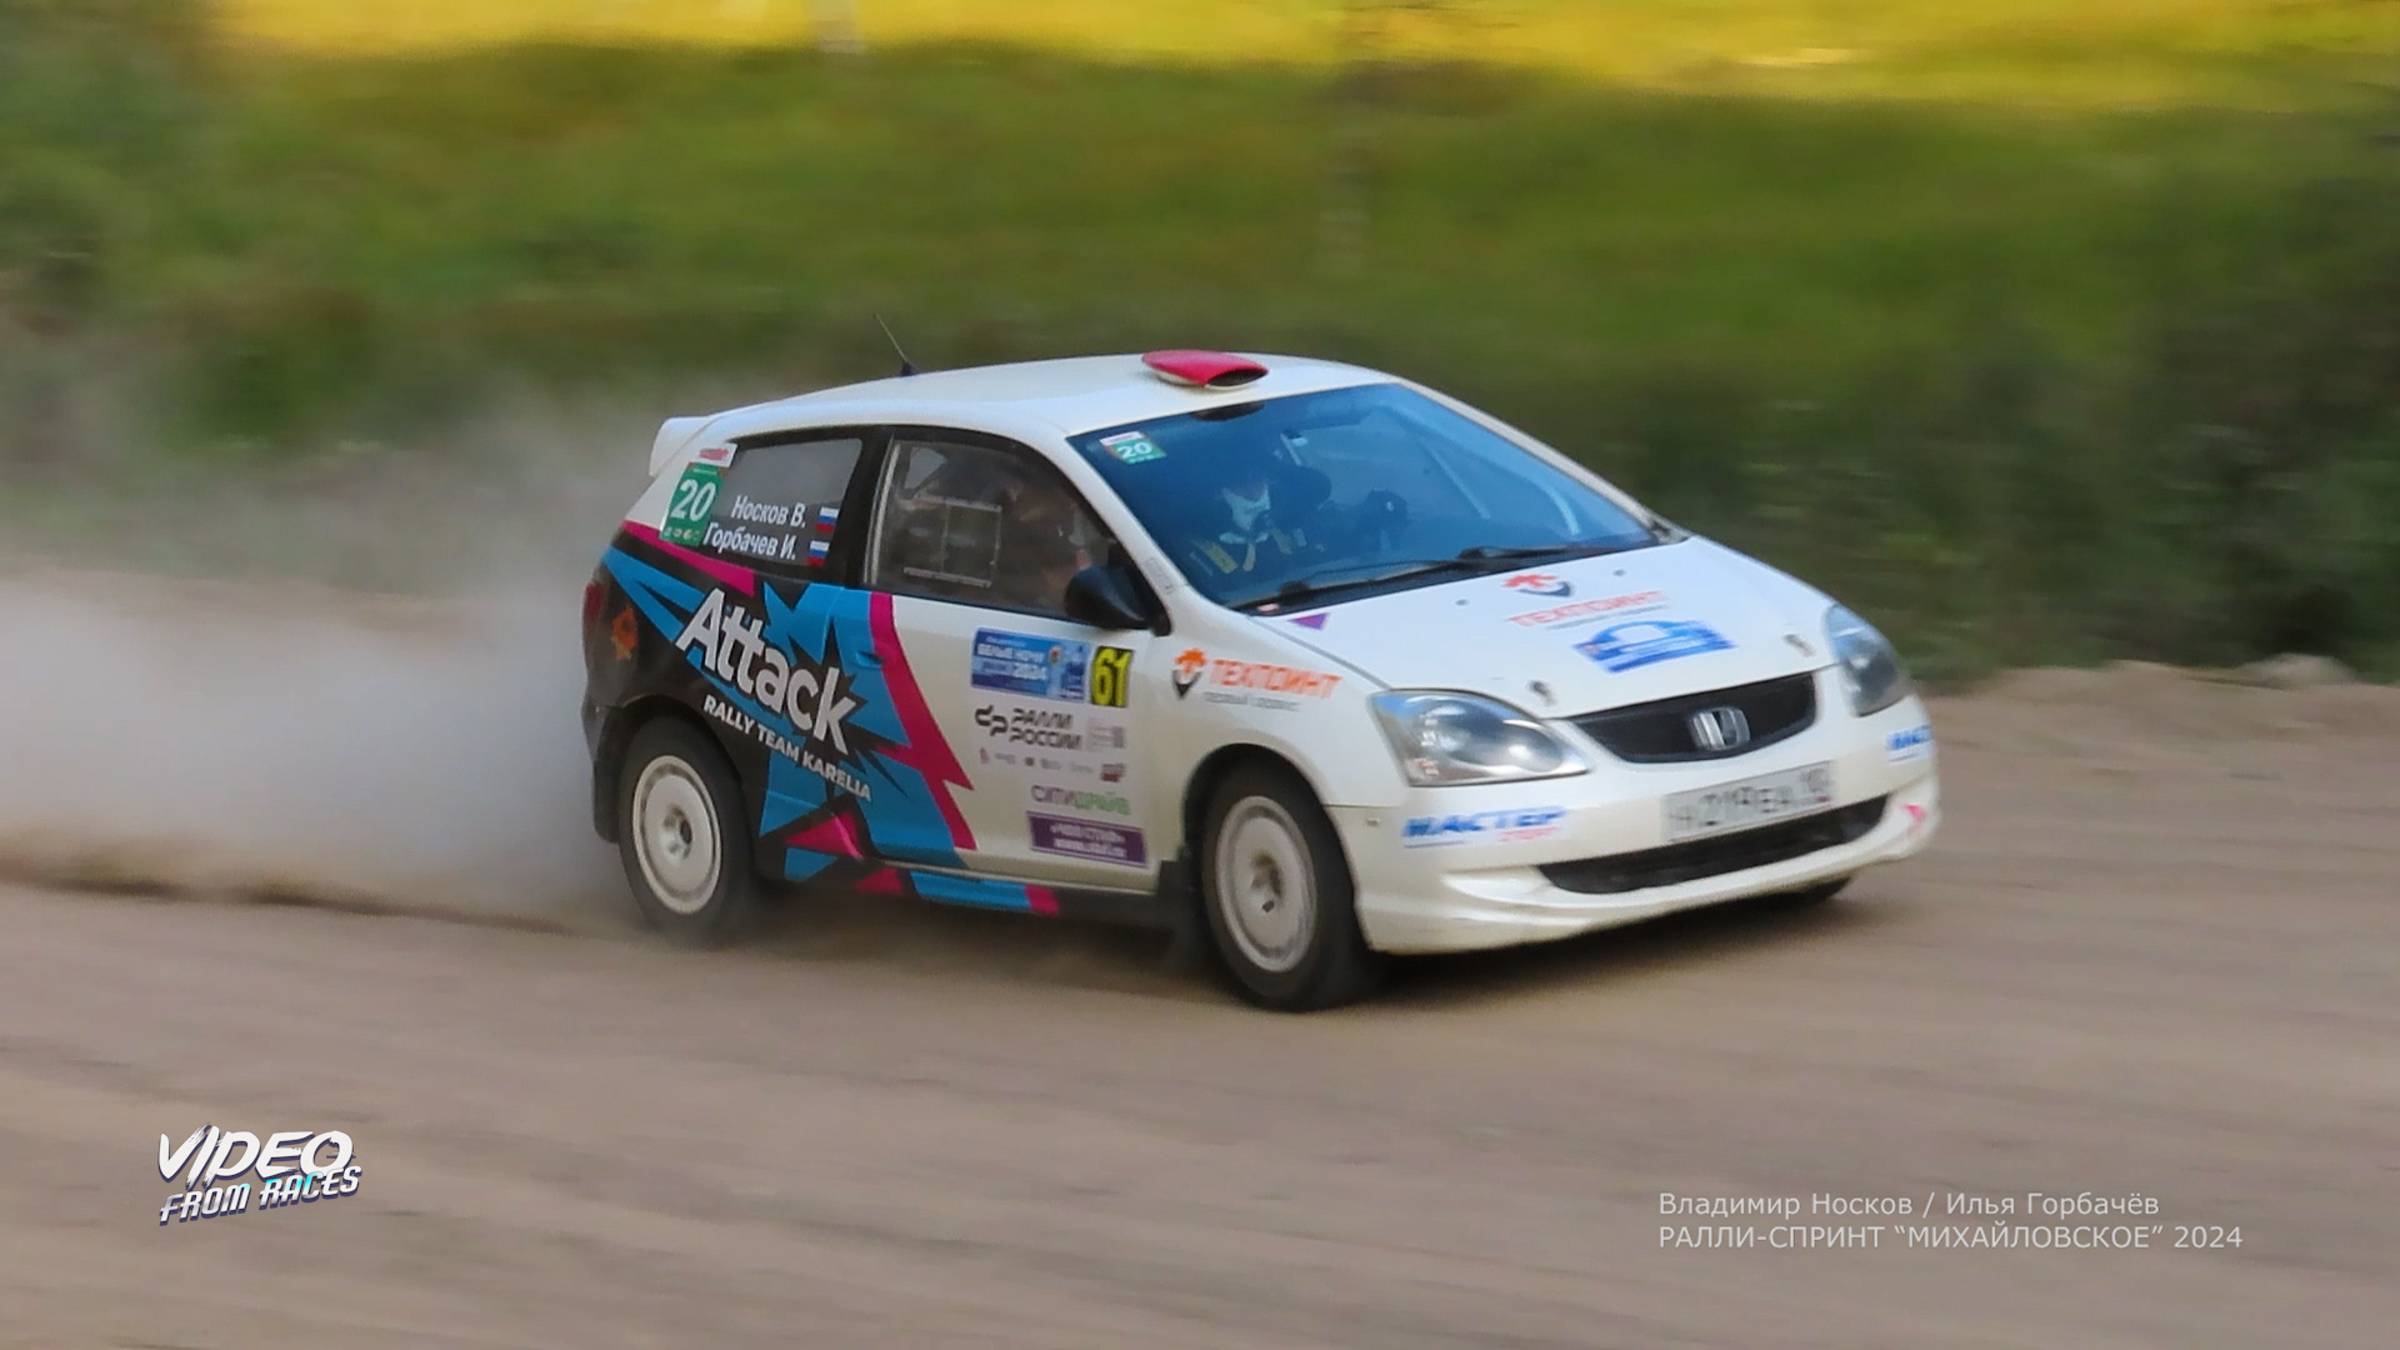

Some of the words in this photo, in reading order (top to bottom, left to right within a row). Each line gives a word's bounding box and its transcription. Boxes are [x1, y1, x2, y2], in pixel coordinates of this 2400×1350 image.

[1117, 441, 1153, 459] 20
[670, 479, 717, 522] 20
[731, 495, 788, 525] Носков
[789, 501, 807, 528] В.
[702, 521, 779, 560] Горбачев
[780, 536, 797, 560] И.
[675, 587, 856, 754] Attack
[1091, 646, 1133, 708] 61
[1011, 707, 1073, 729] РАЛЛИ
[703, 694, 755, 735] RALLY
[757, 723, 800, 762] TEAM
[802, 750, 872, 802] KARELIA
[1009, 727, 1082, 750] РОССИИ
